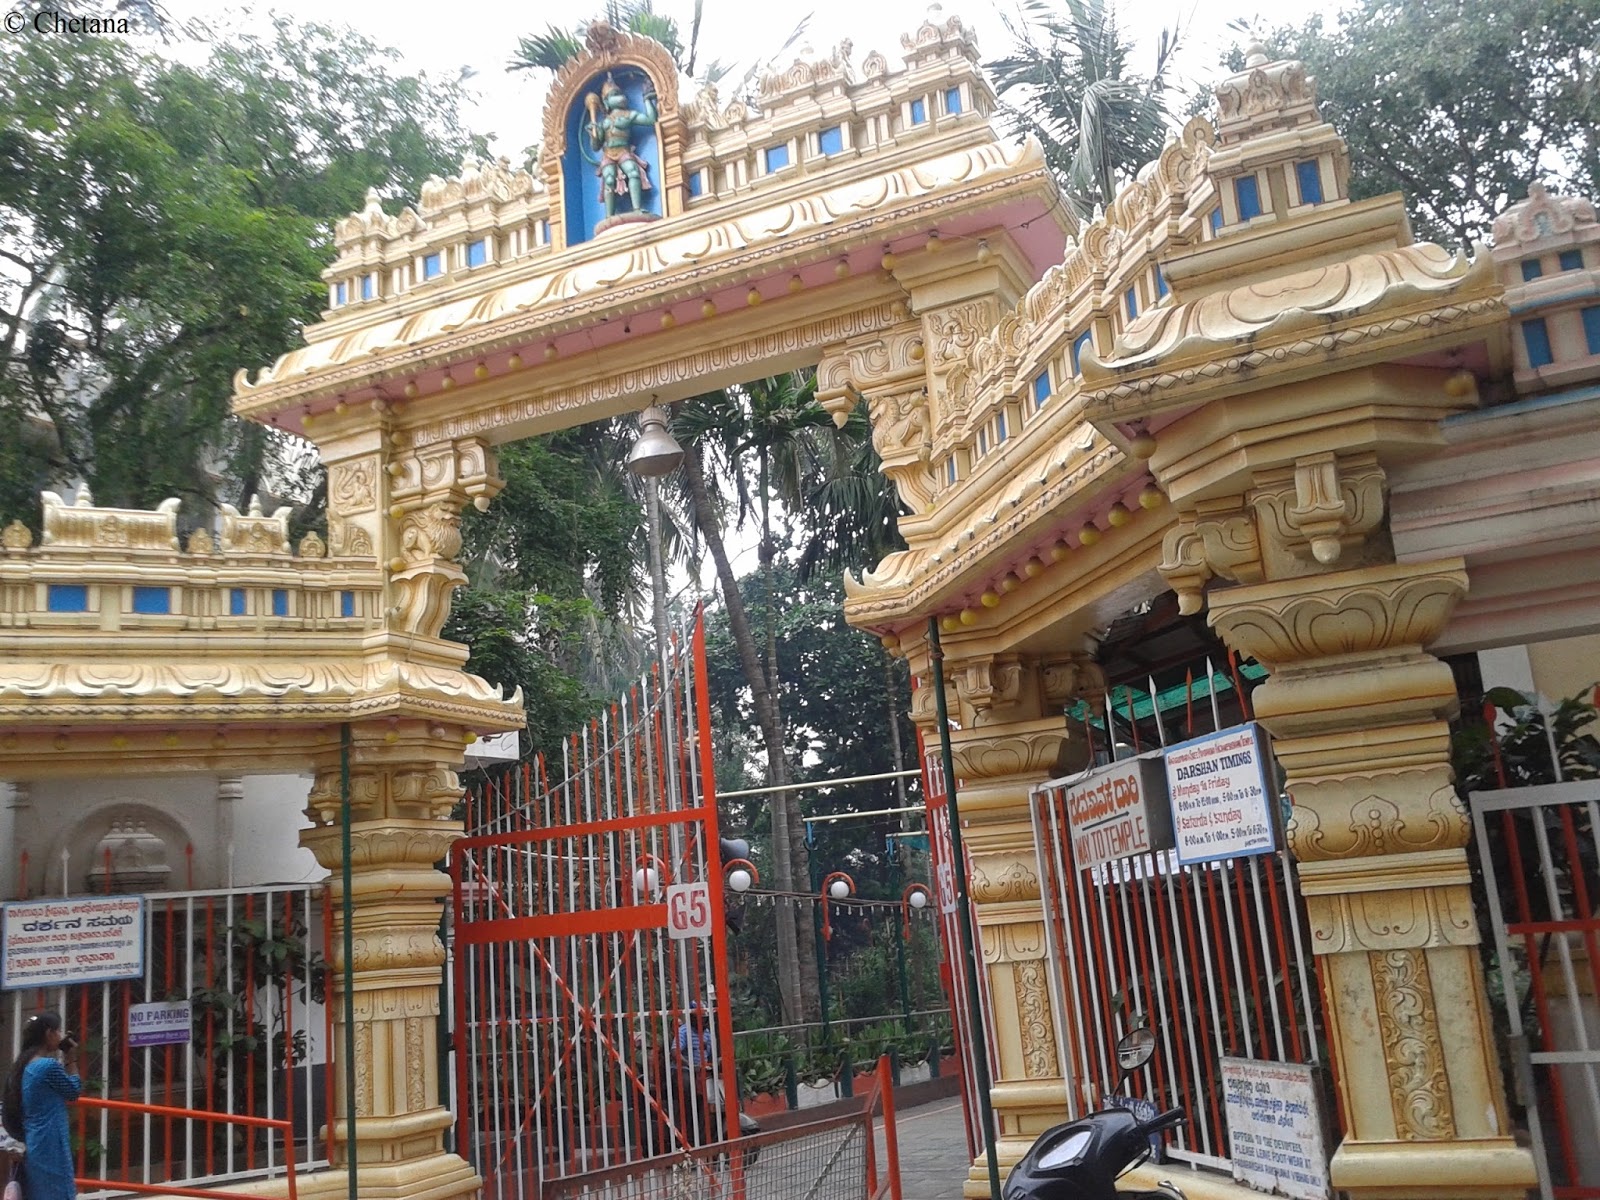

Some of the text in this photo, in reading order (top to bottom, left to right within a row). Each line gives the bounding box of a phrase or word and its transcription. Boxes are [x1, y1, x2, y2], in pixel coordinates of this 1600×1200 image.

[1176, 758, 1219, 781] DARSHAN
[1219, 750, 1252, 770] TIMINGS
[1208, 776, 1231, 788] Friday
[1075, 833, 1092, 865] WAY
[1091, 830, 1106, 860] TO
[1103, 815, 1148, 857] TEMPLE
[671, 889, 707, 930] G5
[22, 914, 133, 932] ದರ್ಶನ ಸಮಯ
[130, 1008, 190, 1022] NO PARKING
